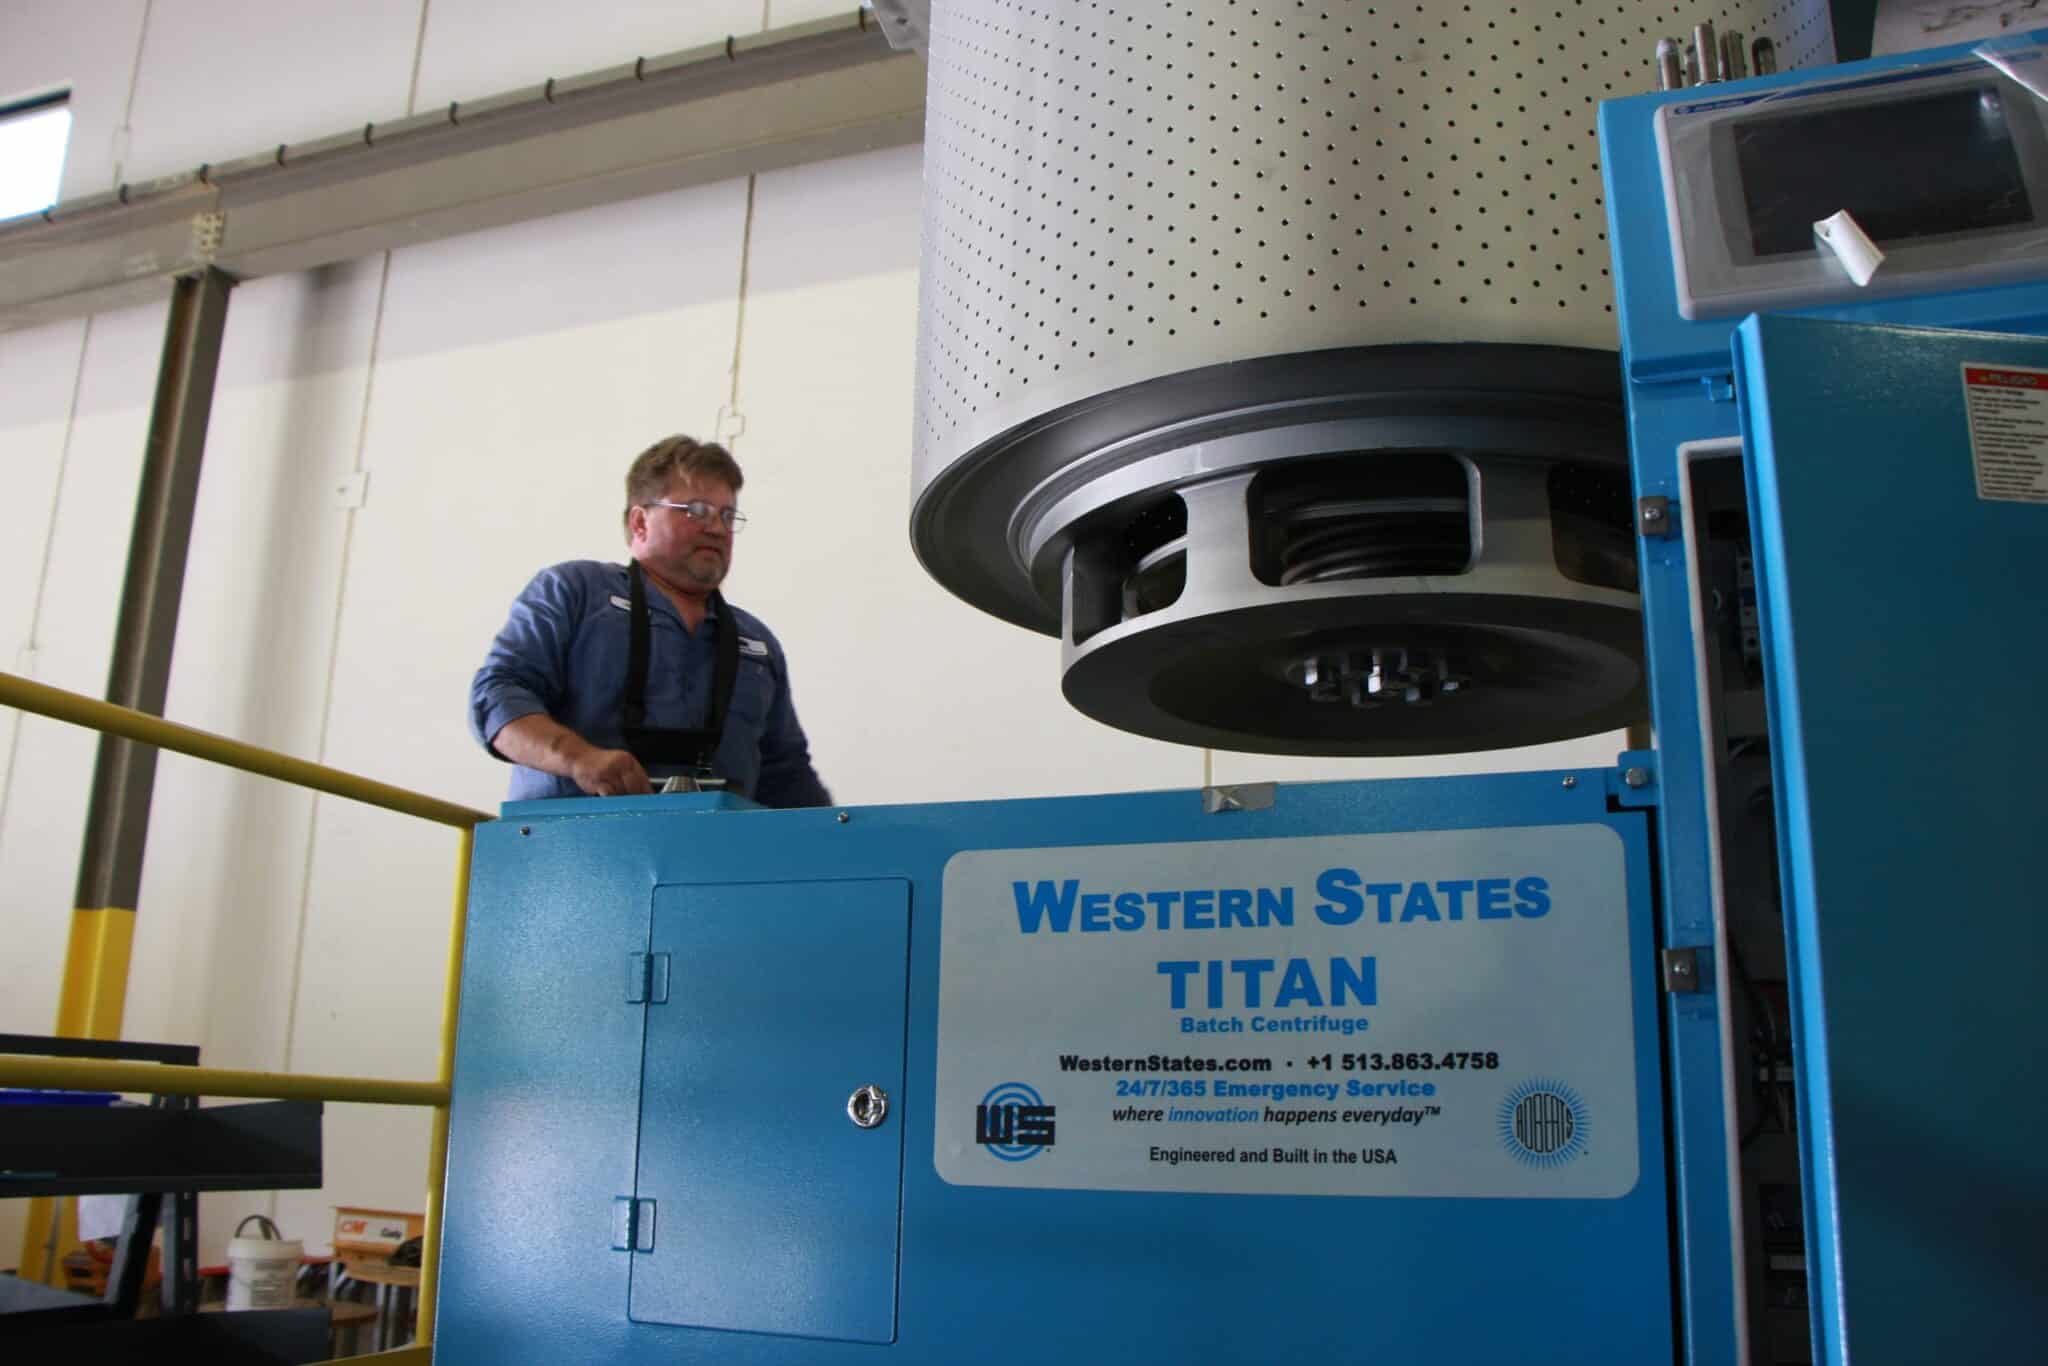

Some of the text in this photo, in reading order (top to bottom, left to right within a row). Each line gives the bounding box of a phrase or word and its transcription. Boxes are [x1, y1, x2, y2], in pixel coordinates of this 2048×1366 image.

[1013, 868, 1552, 934] WESTERN STATES
[1157, 957, 1377, 1009] TITAN
[1180, 1015, 1369, 1036] Batch Centrifuge
[1059, 1051, 1500, 1072] WesternStates.com +1 513.863.4758
[1116, 1079, 1436, 1102] 24/7/365 Emergency Service
[1112, 1106, 1164, 1122] where
[1168, 1106, 1259, 1123] innovation
[1263, 1106, 1337, 1126] happens
[1149, 1146, 1398, 1166] Engineered and Built in the USA
